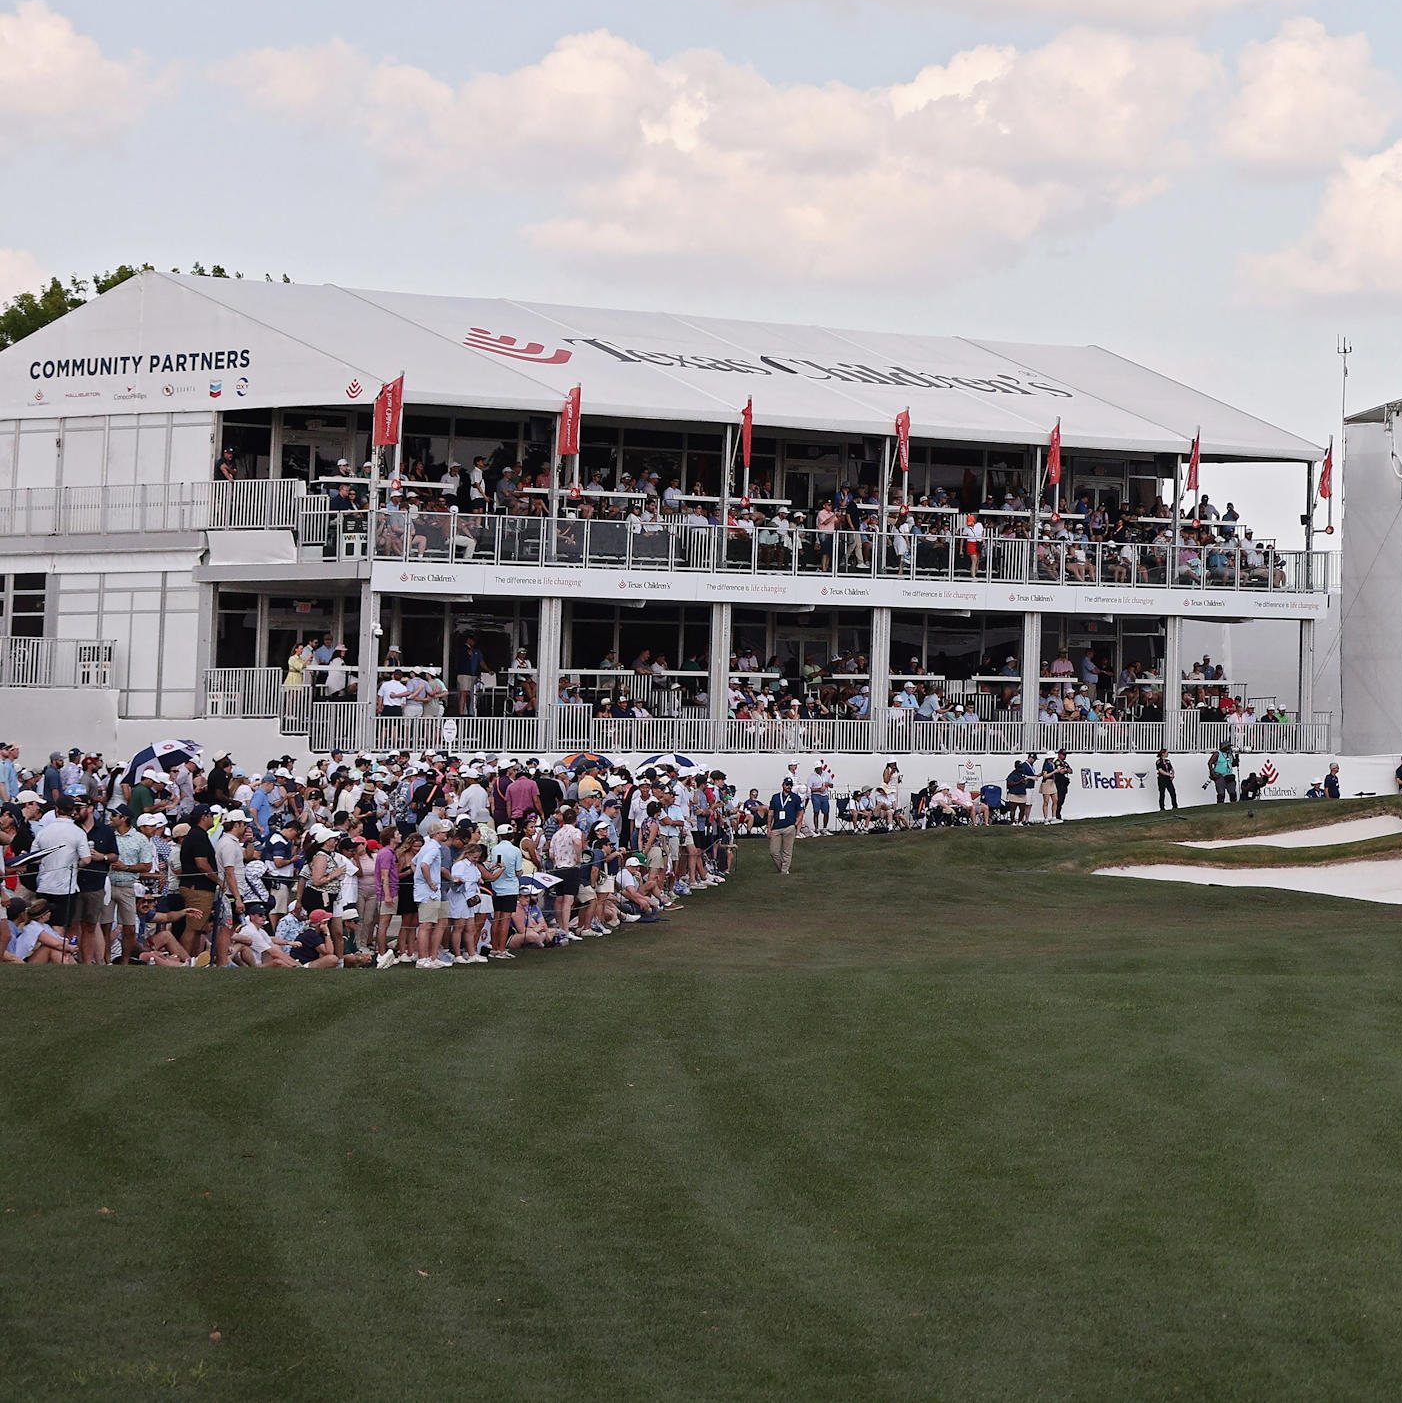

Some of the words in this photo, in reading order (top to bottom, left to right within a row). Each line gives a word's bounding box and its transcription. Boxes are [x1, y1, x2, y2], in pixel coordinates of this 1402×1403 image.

[30, 356, 143, 379] COMMUNITY
[150, 350, 250, 373] PARTNERS
[562, 338, 772, 375] Texas
[760, 354, 1073, 398] Children's
[410, 573, 426, 582] Texas
[427, 574, 457, 583] Children's
[507, 576, 536, 585] difference
[554, 578, 582, 587] changing
[644, 581, 671, 589] Children's
[706, 583, 716, 591] The
[717, 584, 744, 592] difference
[761, 585, 787, 594] changing
[1094, 772, 1134, 789] FedEx
[1264, 787, 1297, 797] Children's
